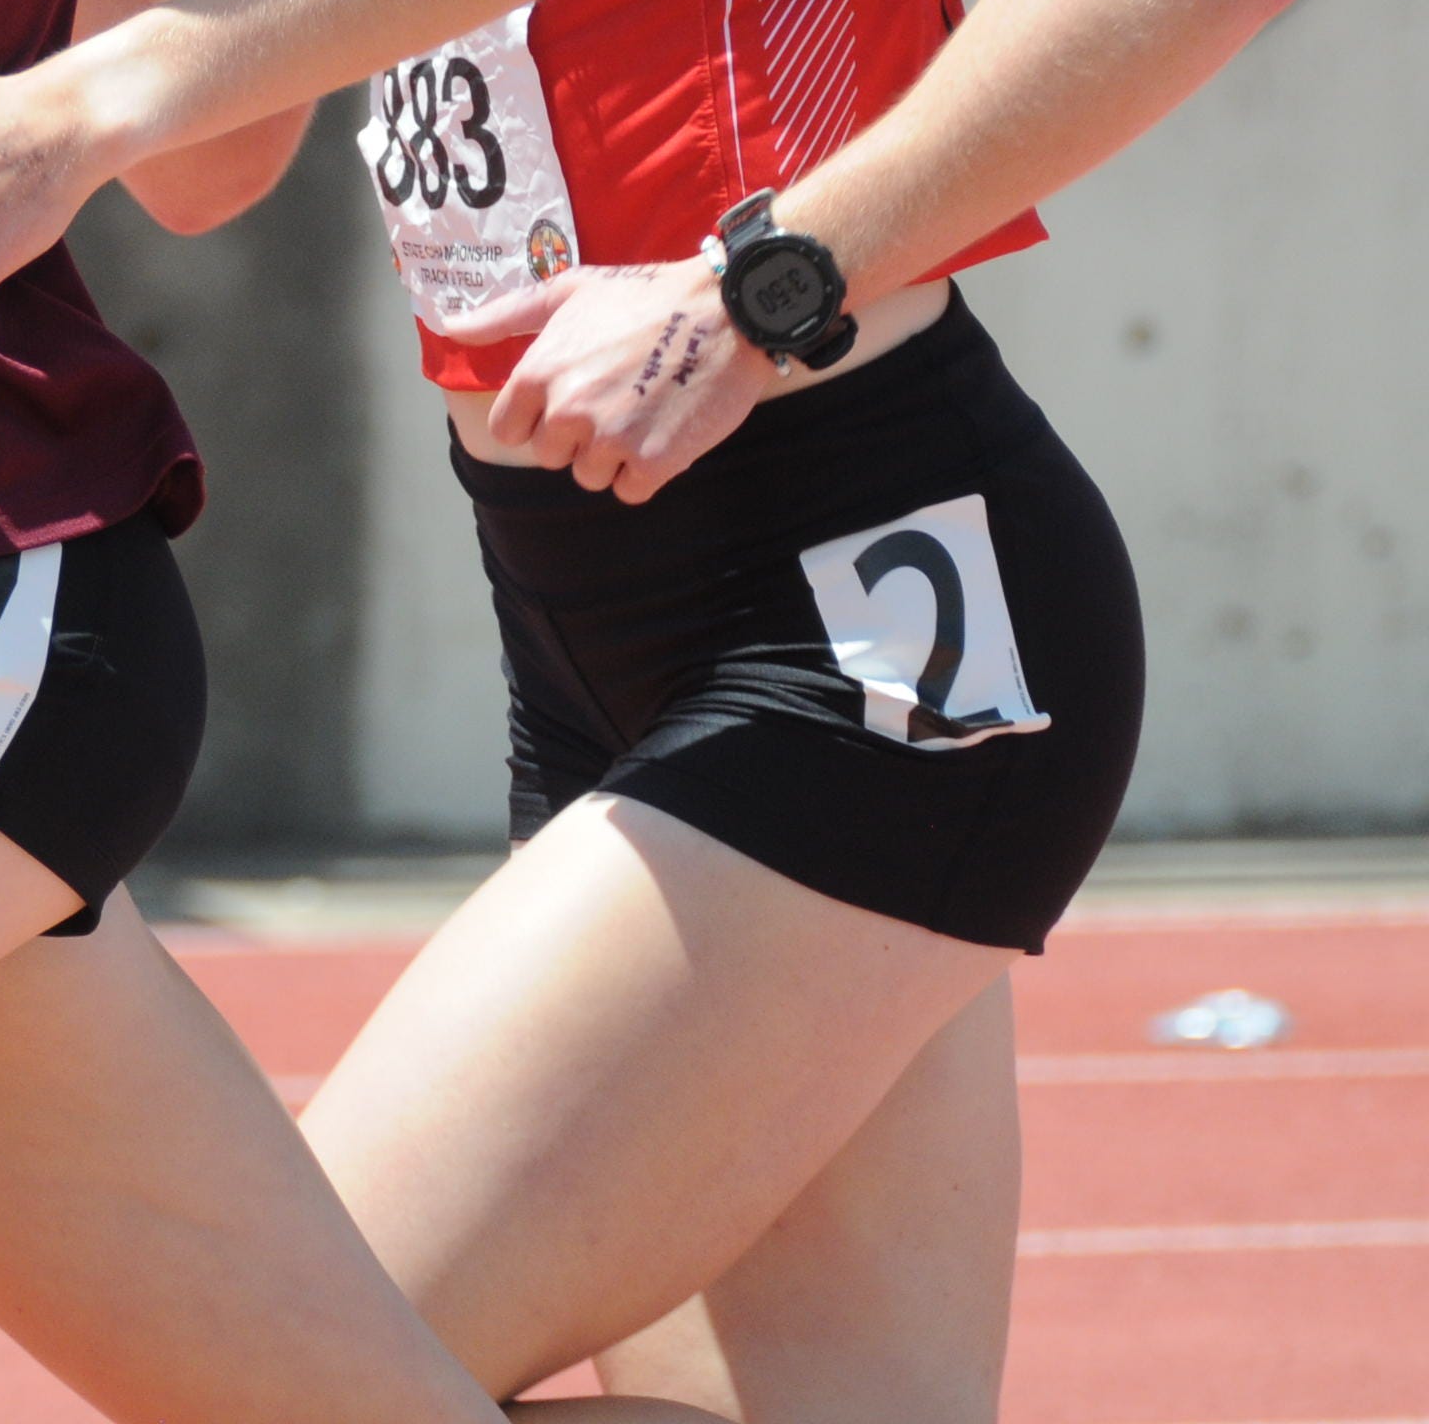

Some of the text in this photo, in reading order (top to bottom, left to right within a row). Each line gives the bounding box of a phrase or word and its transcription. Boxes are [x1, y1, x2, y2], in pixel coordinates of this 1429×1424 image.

[377, 57, 507, 210] 883
[420, 268, 450, 285] TRACK
[853, 529, 1015, 744] 2
